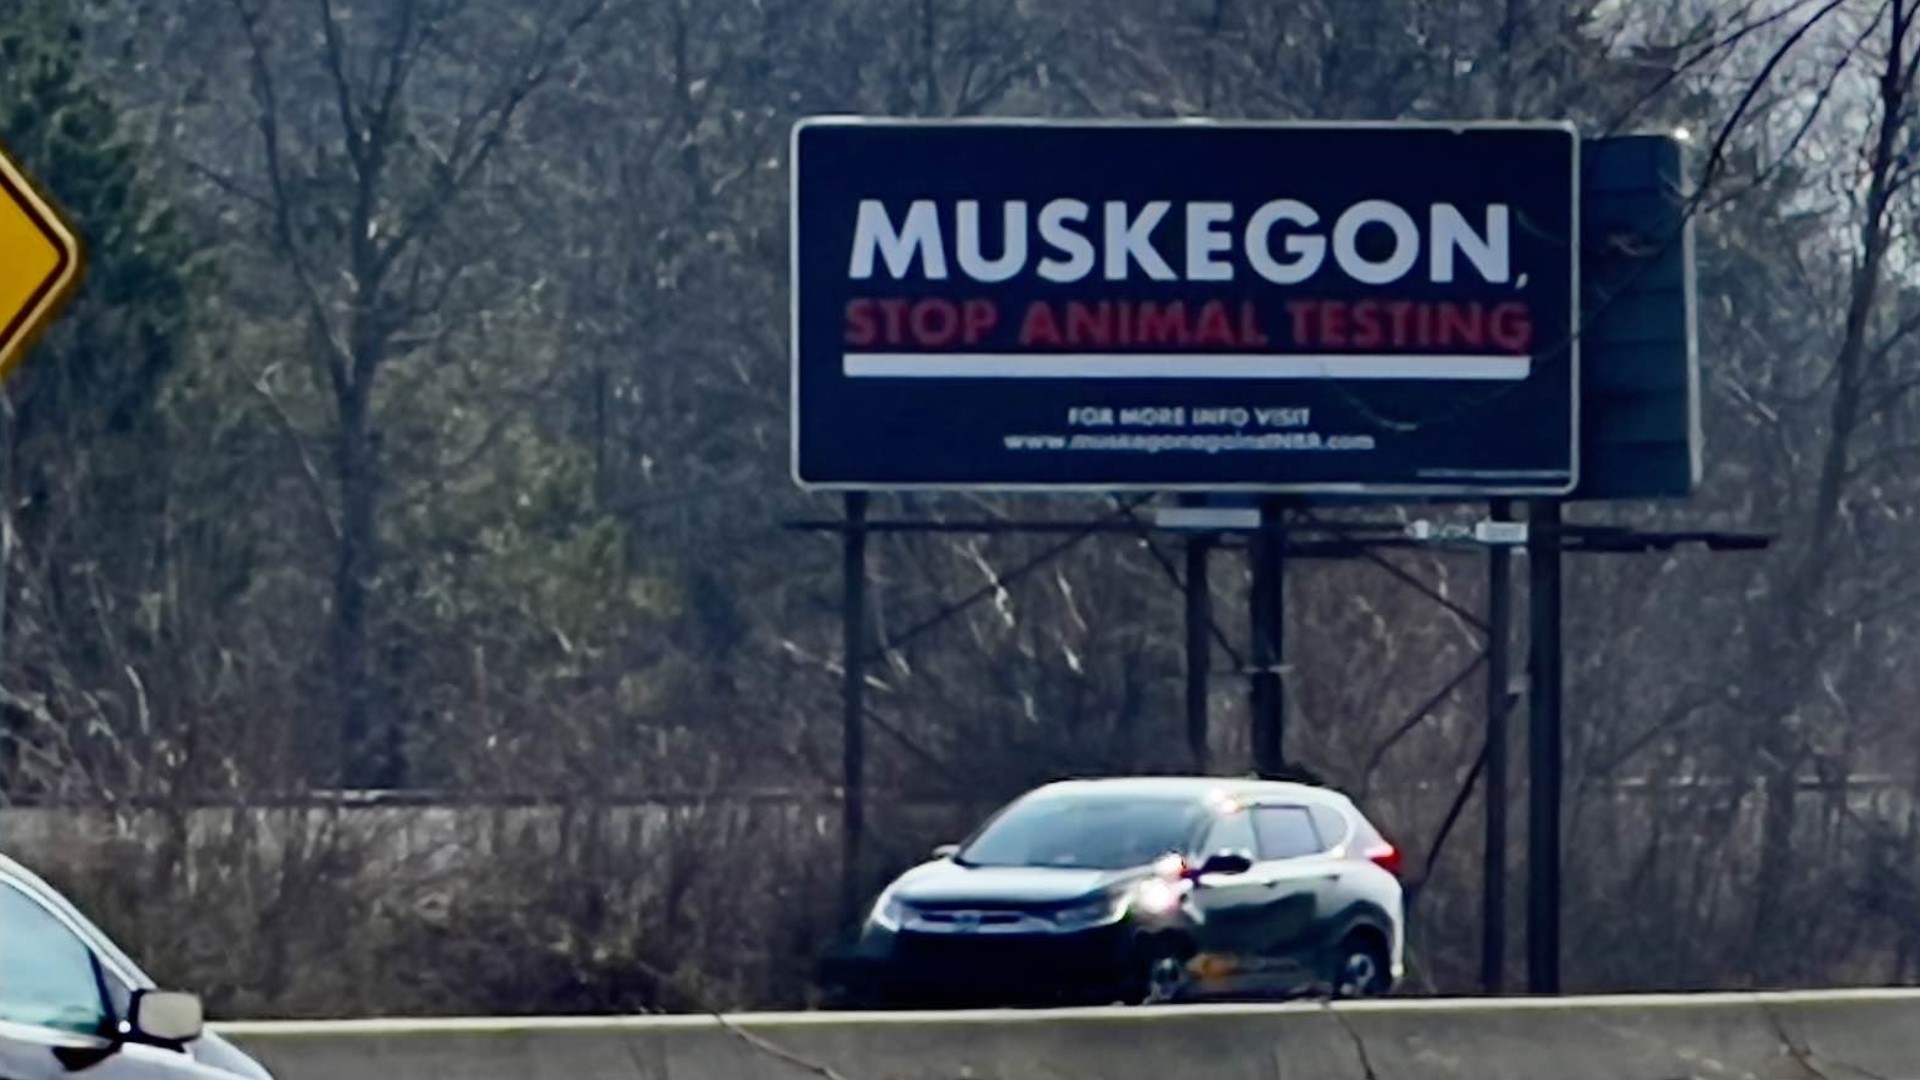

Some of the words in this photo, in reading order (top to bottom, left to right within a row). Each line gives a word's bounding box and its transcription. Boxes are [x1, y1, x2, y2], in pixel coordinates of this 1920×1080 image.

[848, 198, 1530, 289] MUSKEGON,
[844, 299, 998, 345] STOP
[1019, 300, 1268, 345] ANIMAL
[1289, 300, 1533, 353] TESTING
[1067, 406, 1115, 427] FOR
[1119, 406, 1186, 428] MORE
[1191, 406, 1250, 428] INFO
[1253, 406, 1312, 428] VISIT
